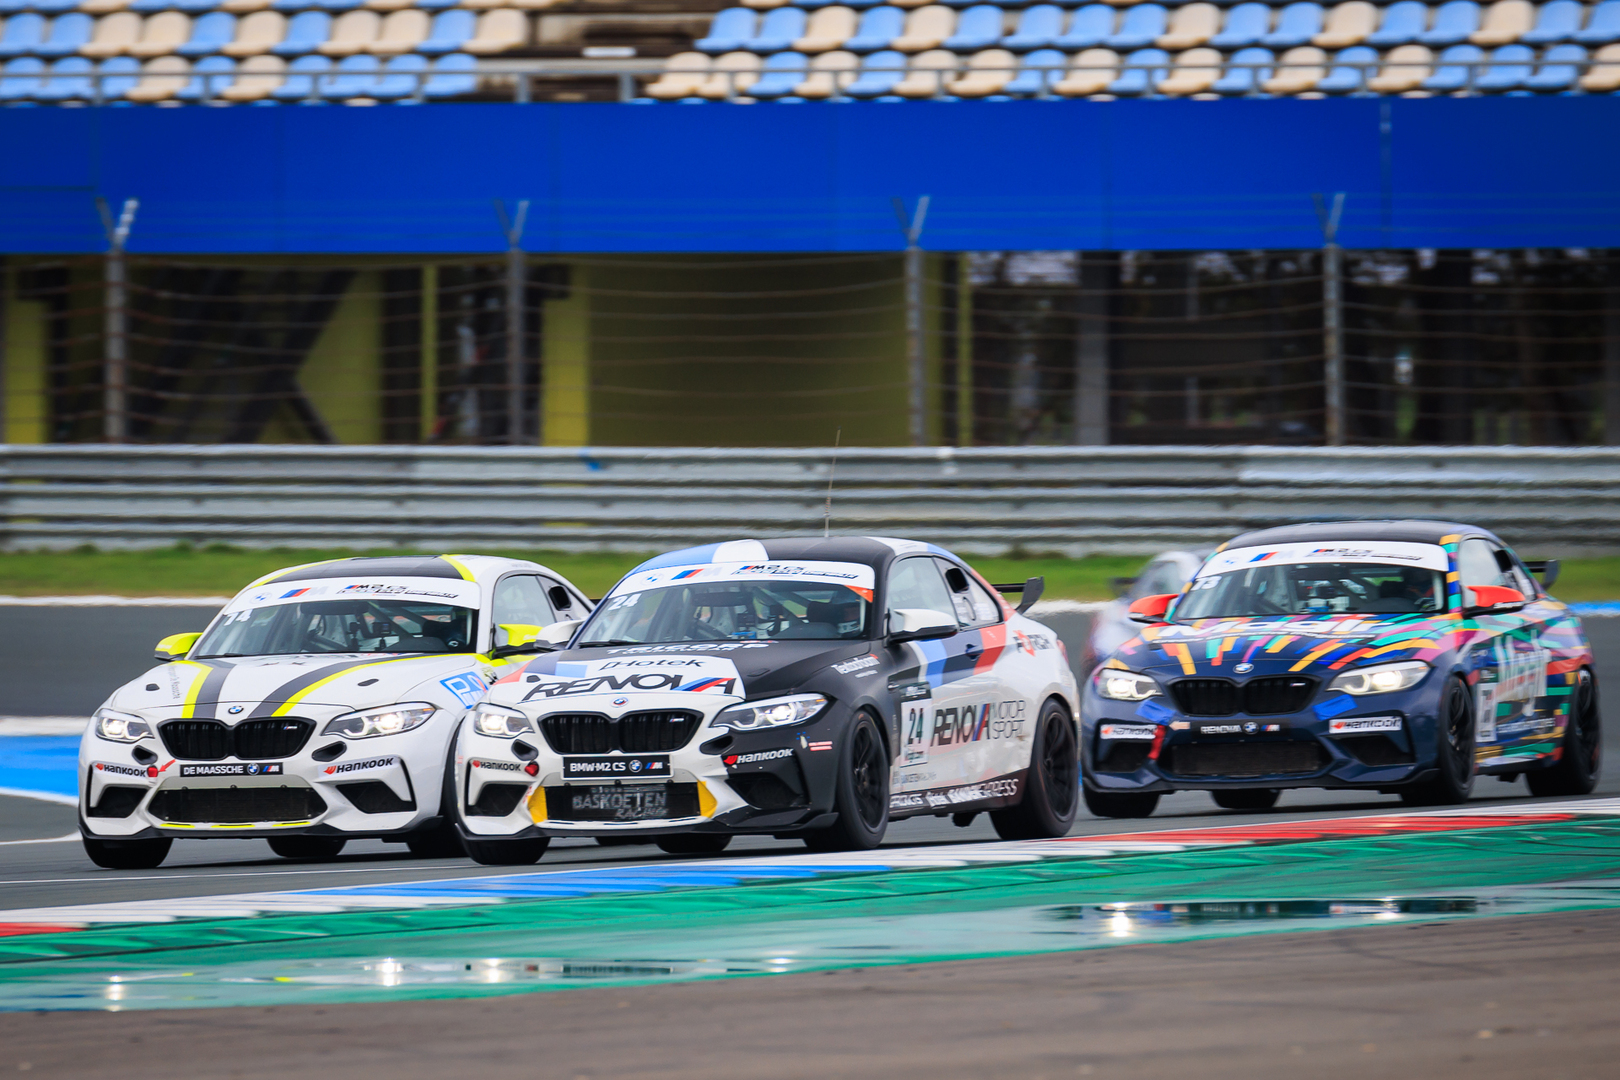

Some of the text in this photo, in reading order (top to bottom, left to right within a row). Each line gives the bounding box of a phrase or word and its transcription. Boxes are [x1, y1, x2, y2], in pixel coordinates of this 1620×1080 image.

[607, 593, 642, 611] 24
[524, 673, 737, 700] RENOVA
[992, 700, 1027, 719] MOTOR
[908, 707, 924, 745] 24
[931, 704, 990, 747] RENOVA
[992, 719, 1026, 740] SPORT
[183, 767, 196, 775] DE
[197, 765, 244, 774] MAASSCHE
[612, 762, 626, 771] CS
